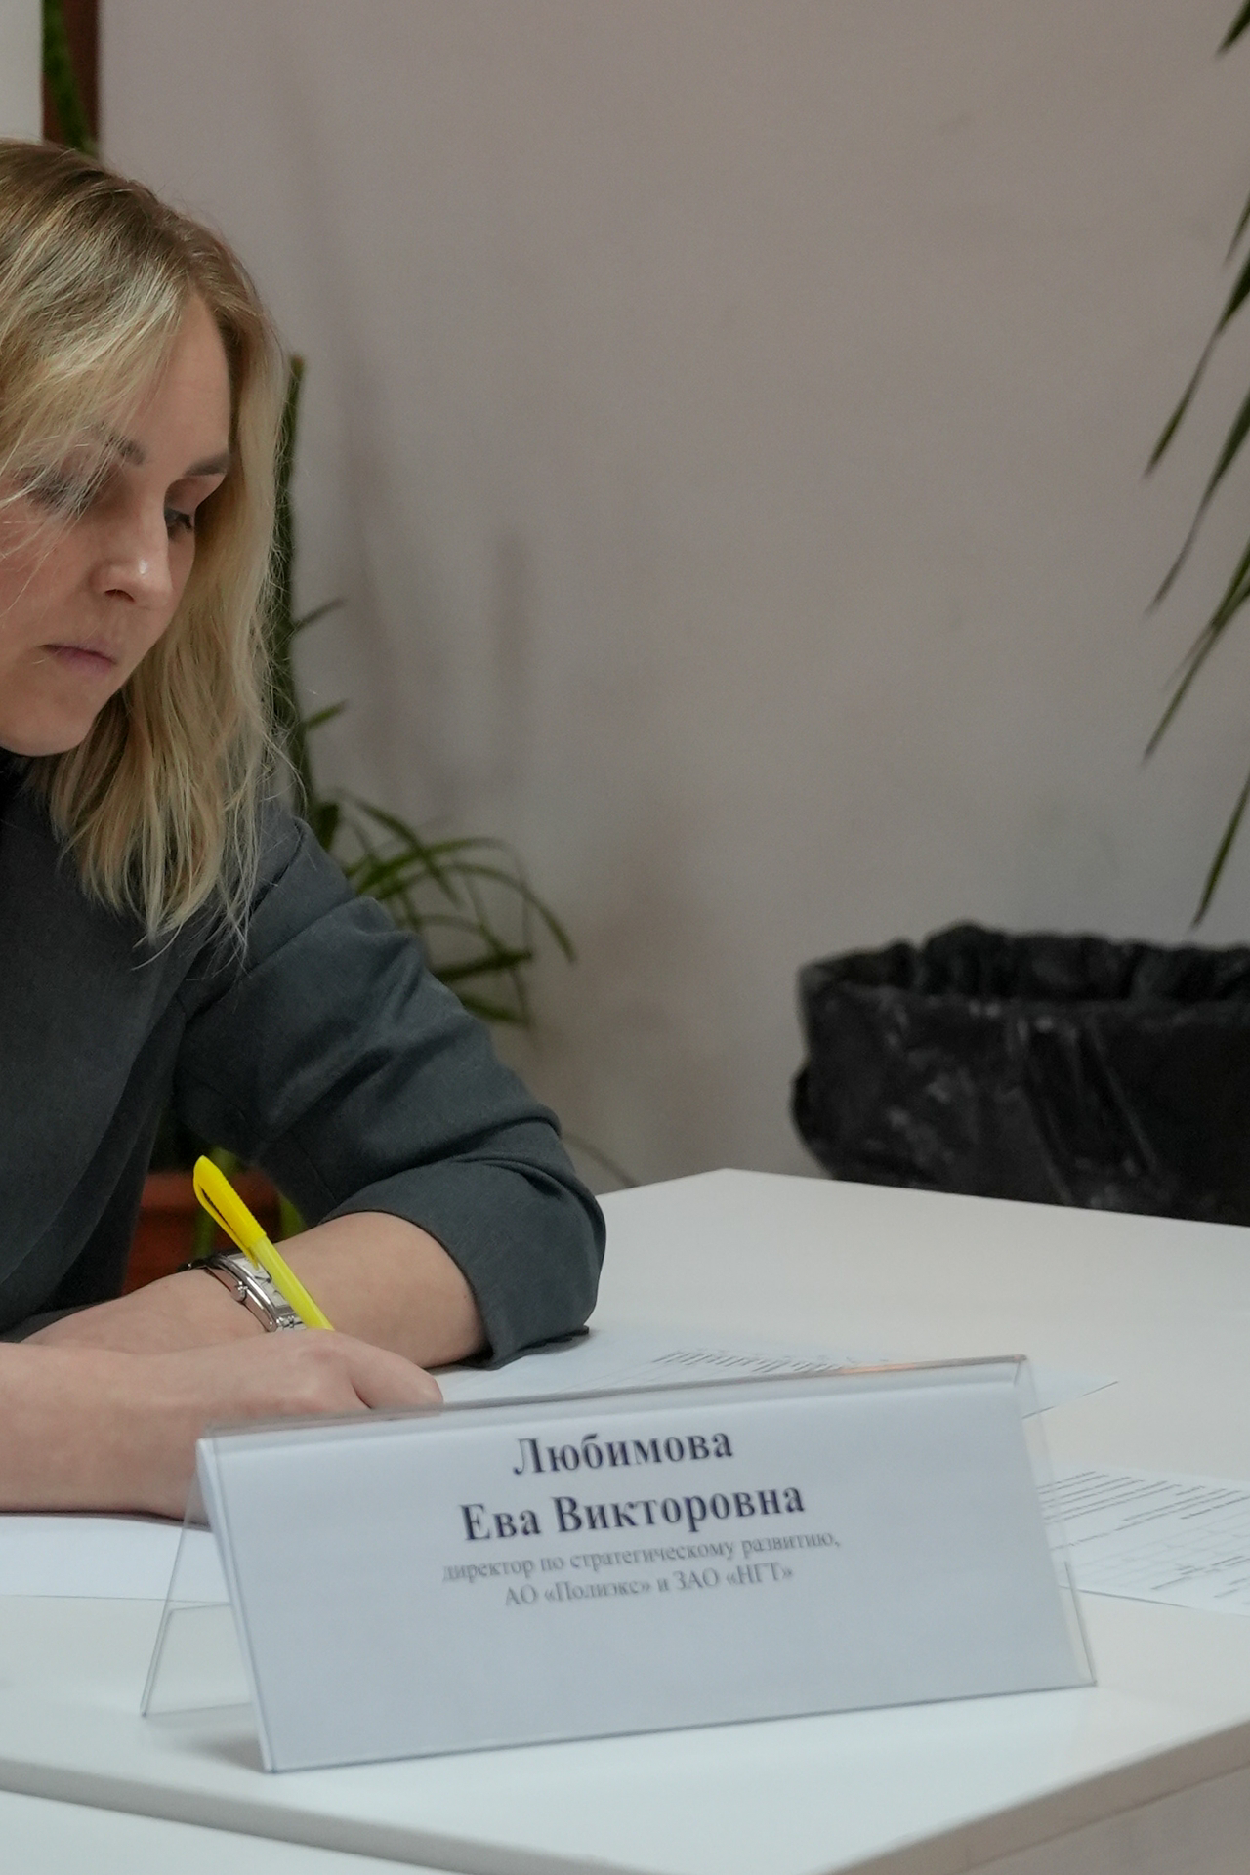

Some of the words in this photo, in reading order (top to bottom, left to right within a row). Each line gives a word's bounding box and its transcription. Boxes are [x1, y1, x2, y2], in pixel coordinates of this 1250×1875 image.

[513, 1432, 733, 1476] Любимова
[459, 1502, 541, 1541] Ева
[551, 1485, 806, 1533] Викторовна
[442, 1559, 534, 1583] директор
[540, 1556, 564, 1572] по
[569, 1540, 734, 1573] стратегическому
[741, 1532, 840, 1559] развитию,
[505, 1583, 539, 1606] АО
[545, 1579, 650, 1602] «Полиэкс»
[657, 1578, 669, 1593] и
[673, 1567, 721, 1591] ЗАО
[726, 1561, 794, 1586] «НГТ»
